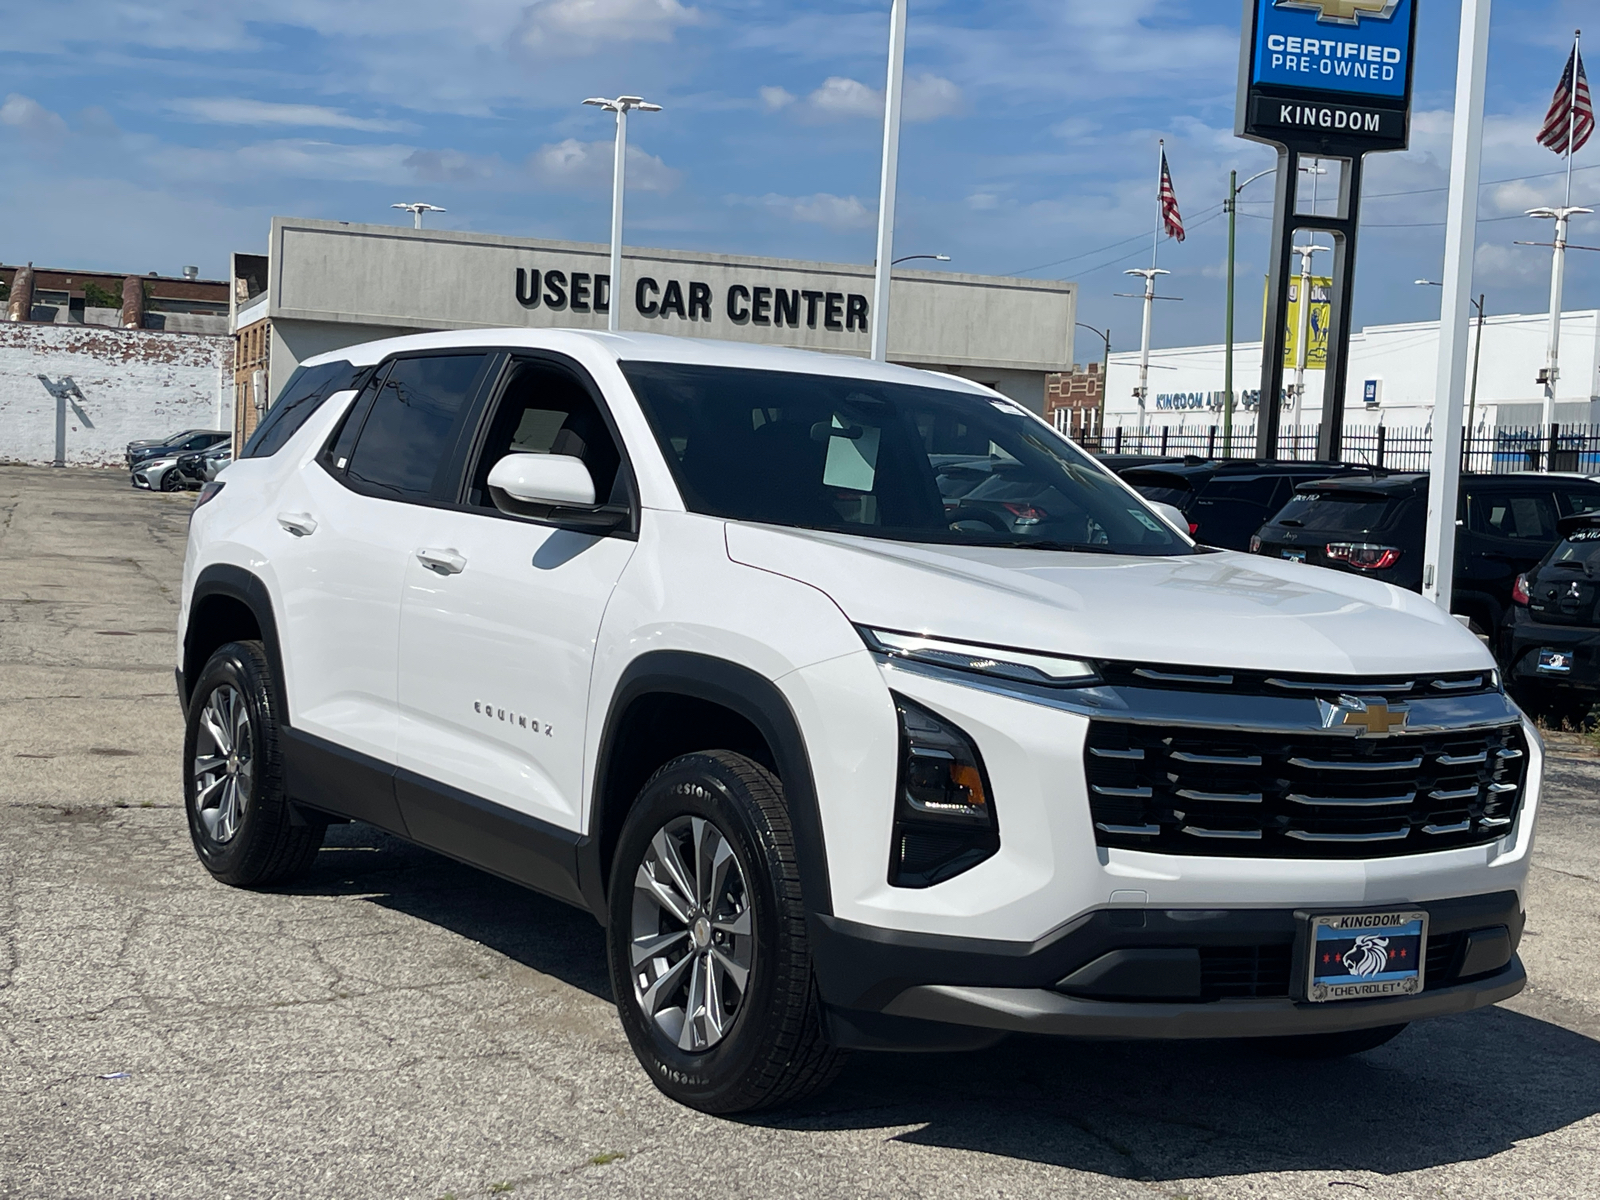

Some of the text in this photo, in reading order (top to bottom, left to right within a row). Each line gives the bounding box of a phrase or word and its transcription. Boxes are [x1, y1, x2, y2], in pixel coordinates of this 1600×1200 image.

[1267, 34, 1401, 64] CERTIFIED
[1271, 53, 1395, 81] PRE-OWNED
[1279, 104, 1380, 132] KINGDOM
[515, 267, 869, 333] USED CAR CENTER
[1156, 392, 1204, 410] KINGDOM
[473, 700, 553, 738] EQUINOX
[1340, 914, 1401, 928] KINGDOM
[1334, 983, 1396, 997] CHEVROLET
